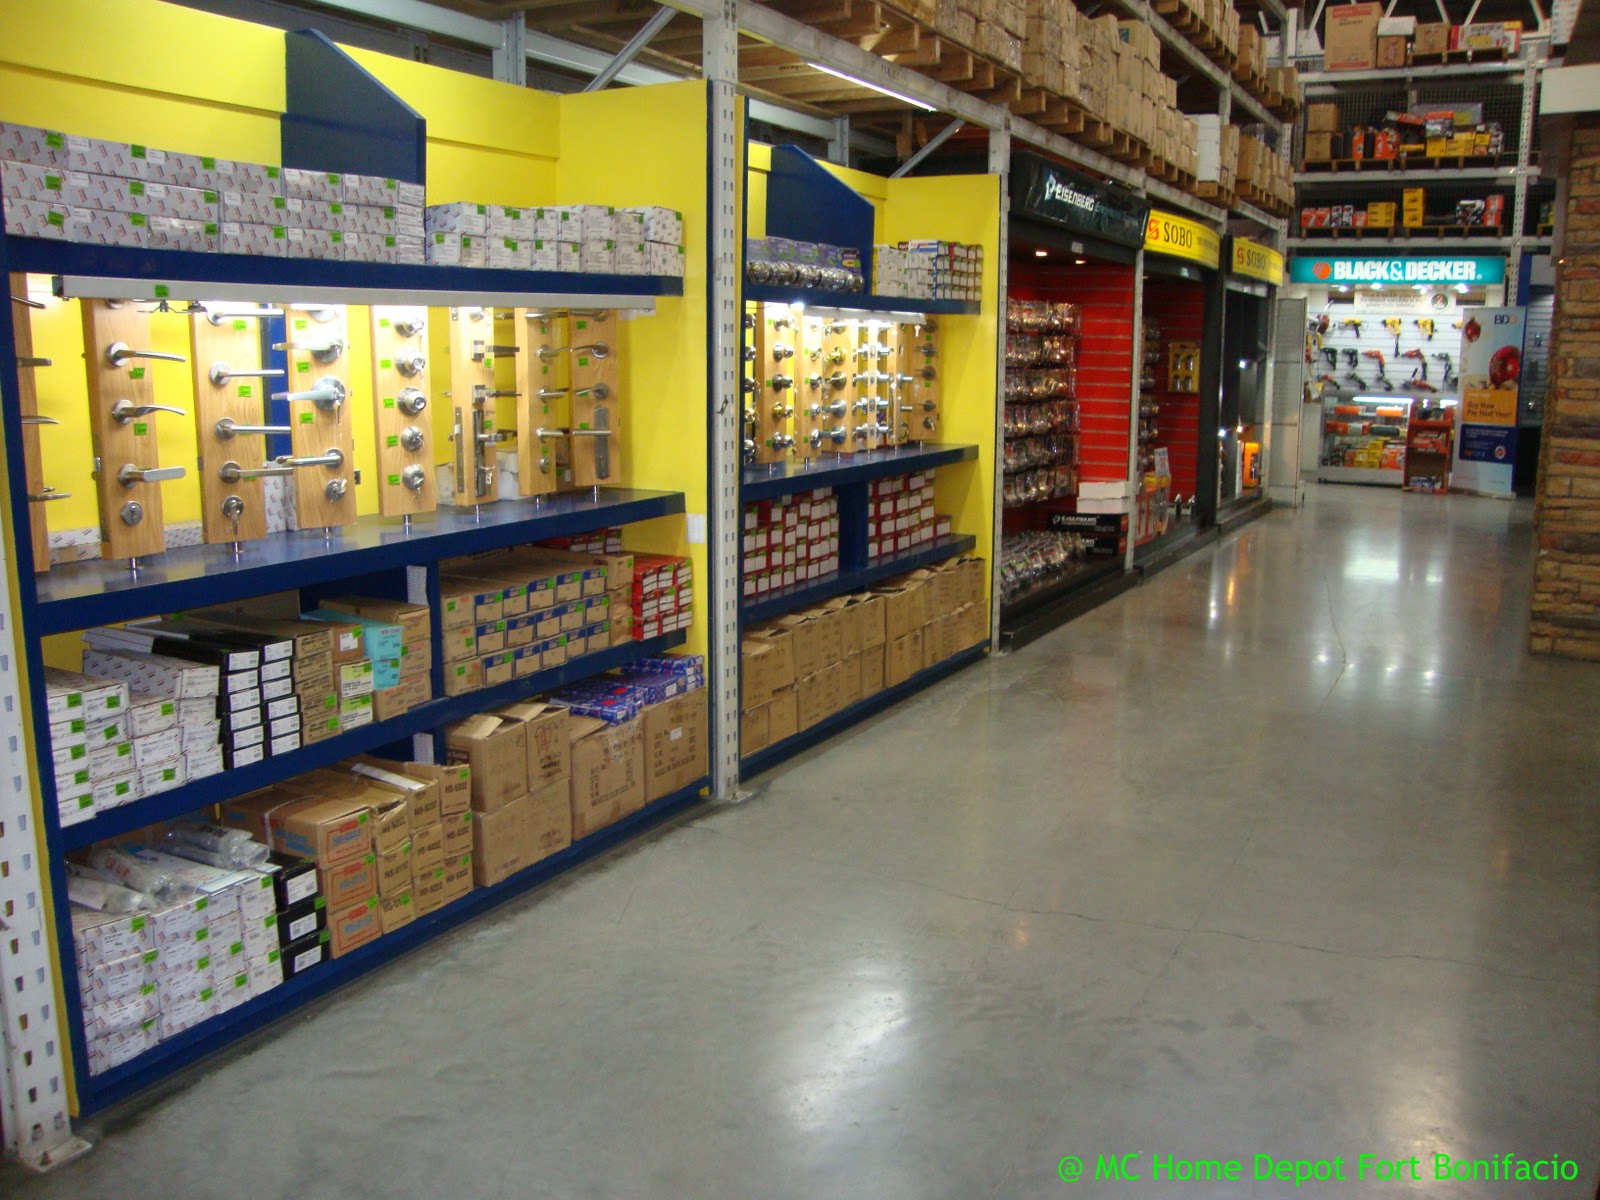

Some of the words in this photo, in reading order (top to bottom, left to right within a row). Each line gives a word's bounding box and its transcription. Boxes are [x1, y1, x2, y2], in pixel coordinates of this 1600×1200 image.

[1054, 183, 1095, 212] EISENBERG
[1163, 221, 1193, 249] SOBO
[1246, 249, 1266, 271] SOBO
